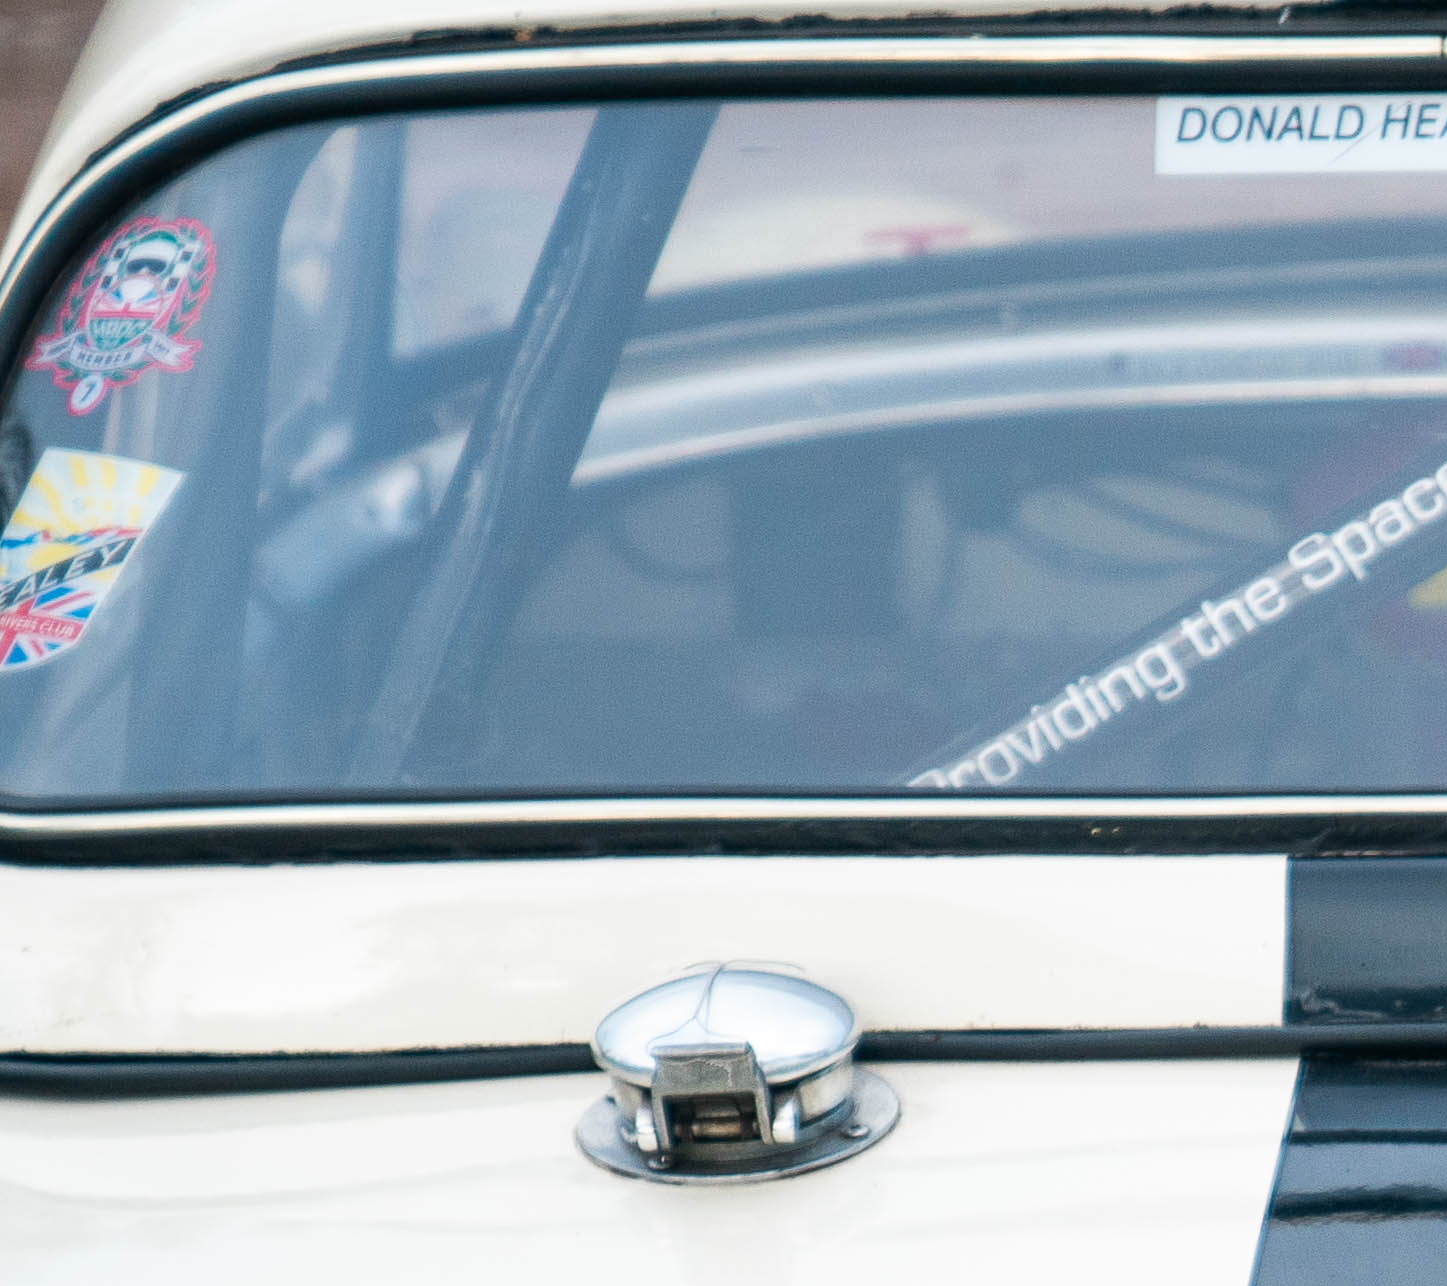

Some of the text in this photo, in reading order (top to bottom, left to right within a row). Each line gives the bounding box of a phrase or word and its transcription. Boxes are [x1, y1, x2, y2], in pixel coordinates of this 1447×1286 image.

[1177, 105, 1365, 142] DONALD
[77, 350, 133, 366] MEMBER
[1182, 578, 1288, 660] the
